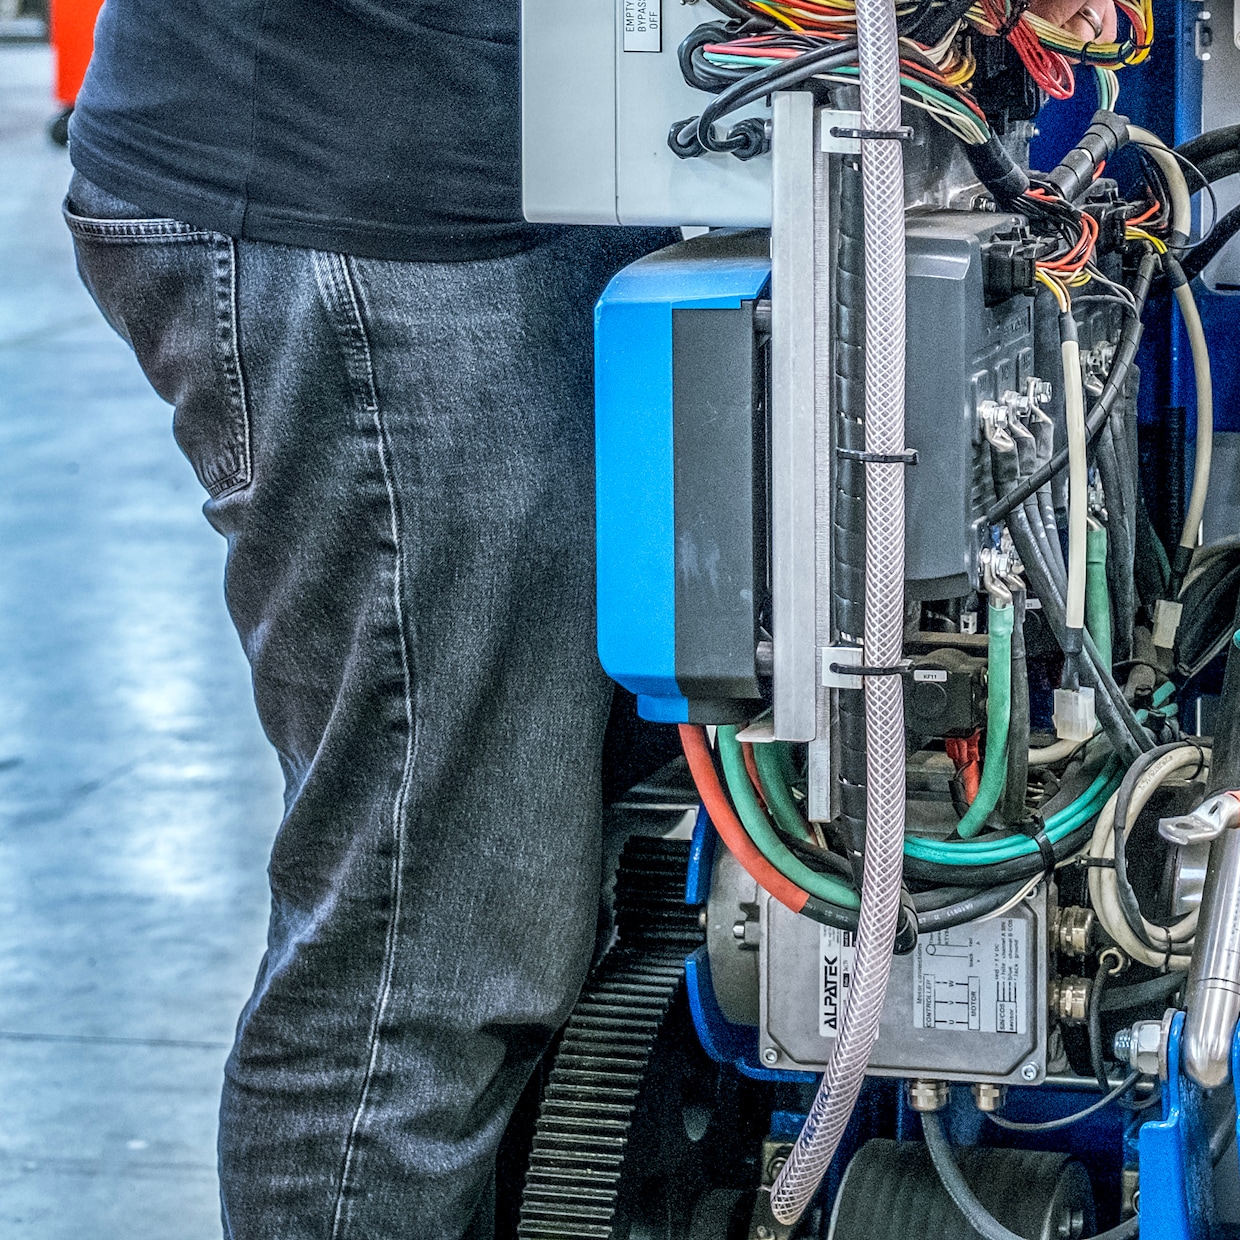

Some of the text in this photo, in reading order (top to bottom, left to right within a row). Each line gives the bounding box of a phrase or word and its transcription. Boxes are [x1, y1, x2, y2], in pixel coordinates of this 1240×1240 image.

[626, 2, 634, 32] EMPTY
[649, 12, 658, 29] OFF
[824, 955, 837, 1030] ALPATEK
